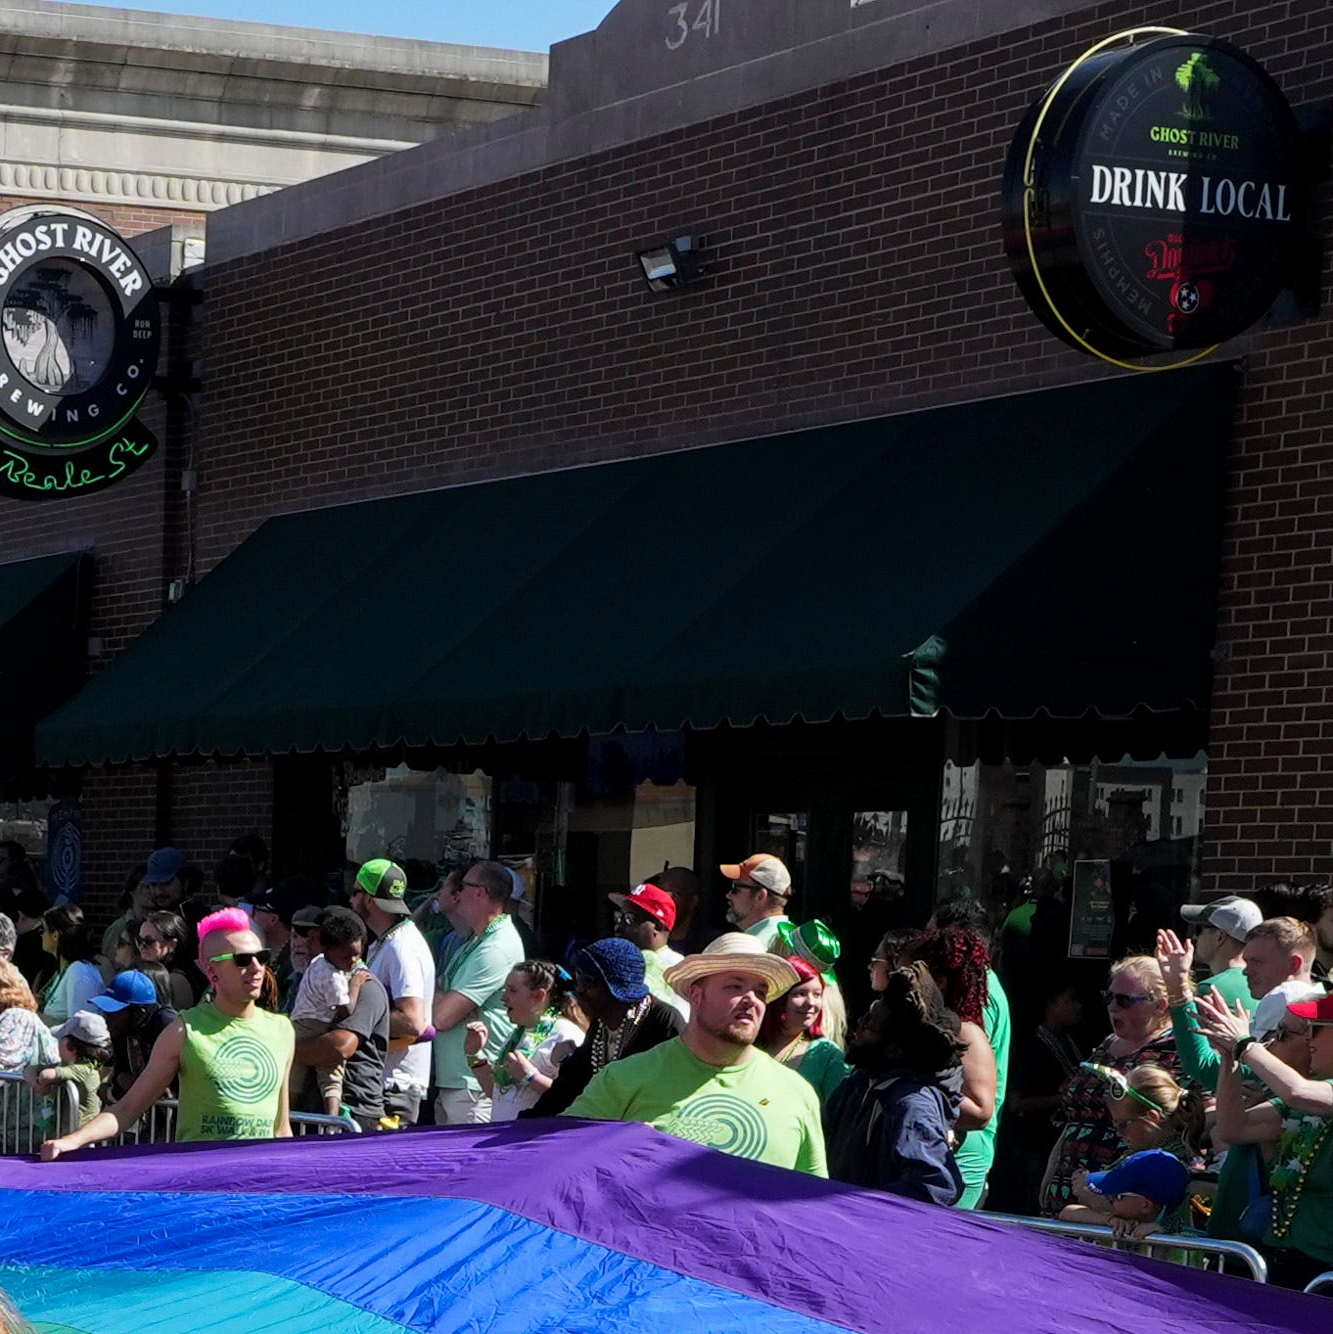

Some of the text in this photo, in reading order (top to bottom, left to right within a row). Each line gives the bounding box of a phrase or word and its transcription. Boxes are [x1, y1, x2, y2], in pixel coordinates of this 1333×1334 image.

[665, 0, 721, 50] 341
[1099, 65, 1164, 141] MADE IN
[1149, 126, 1240, 150] GHOST RIVER
[1090, 164, 1292, 221] DRINK LOCAL
[72, 225, 144, 297] RIVER
[1093, 228, 1153, 316] MEMPHIS
[3, 450, 105, 490] Beale
[109, 437, 149, 478] St
[200, 1124, 213, 1135] 5K
[202, 1115, 254, 1127] RAINBOW
